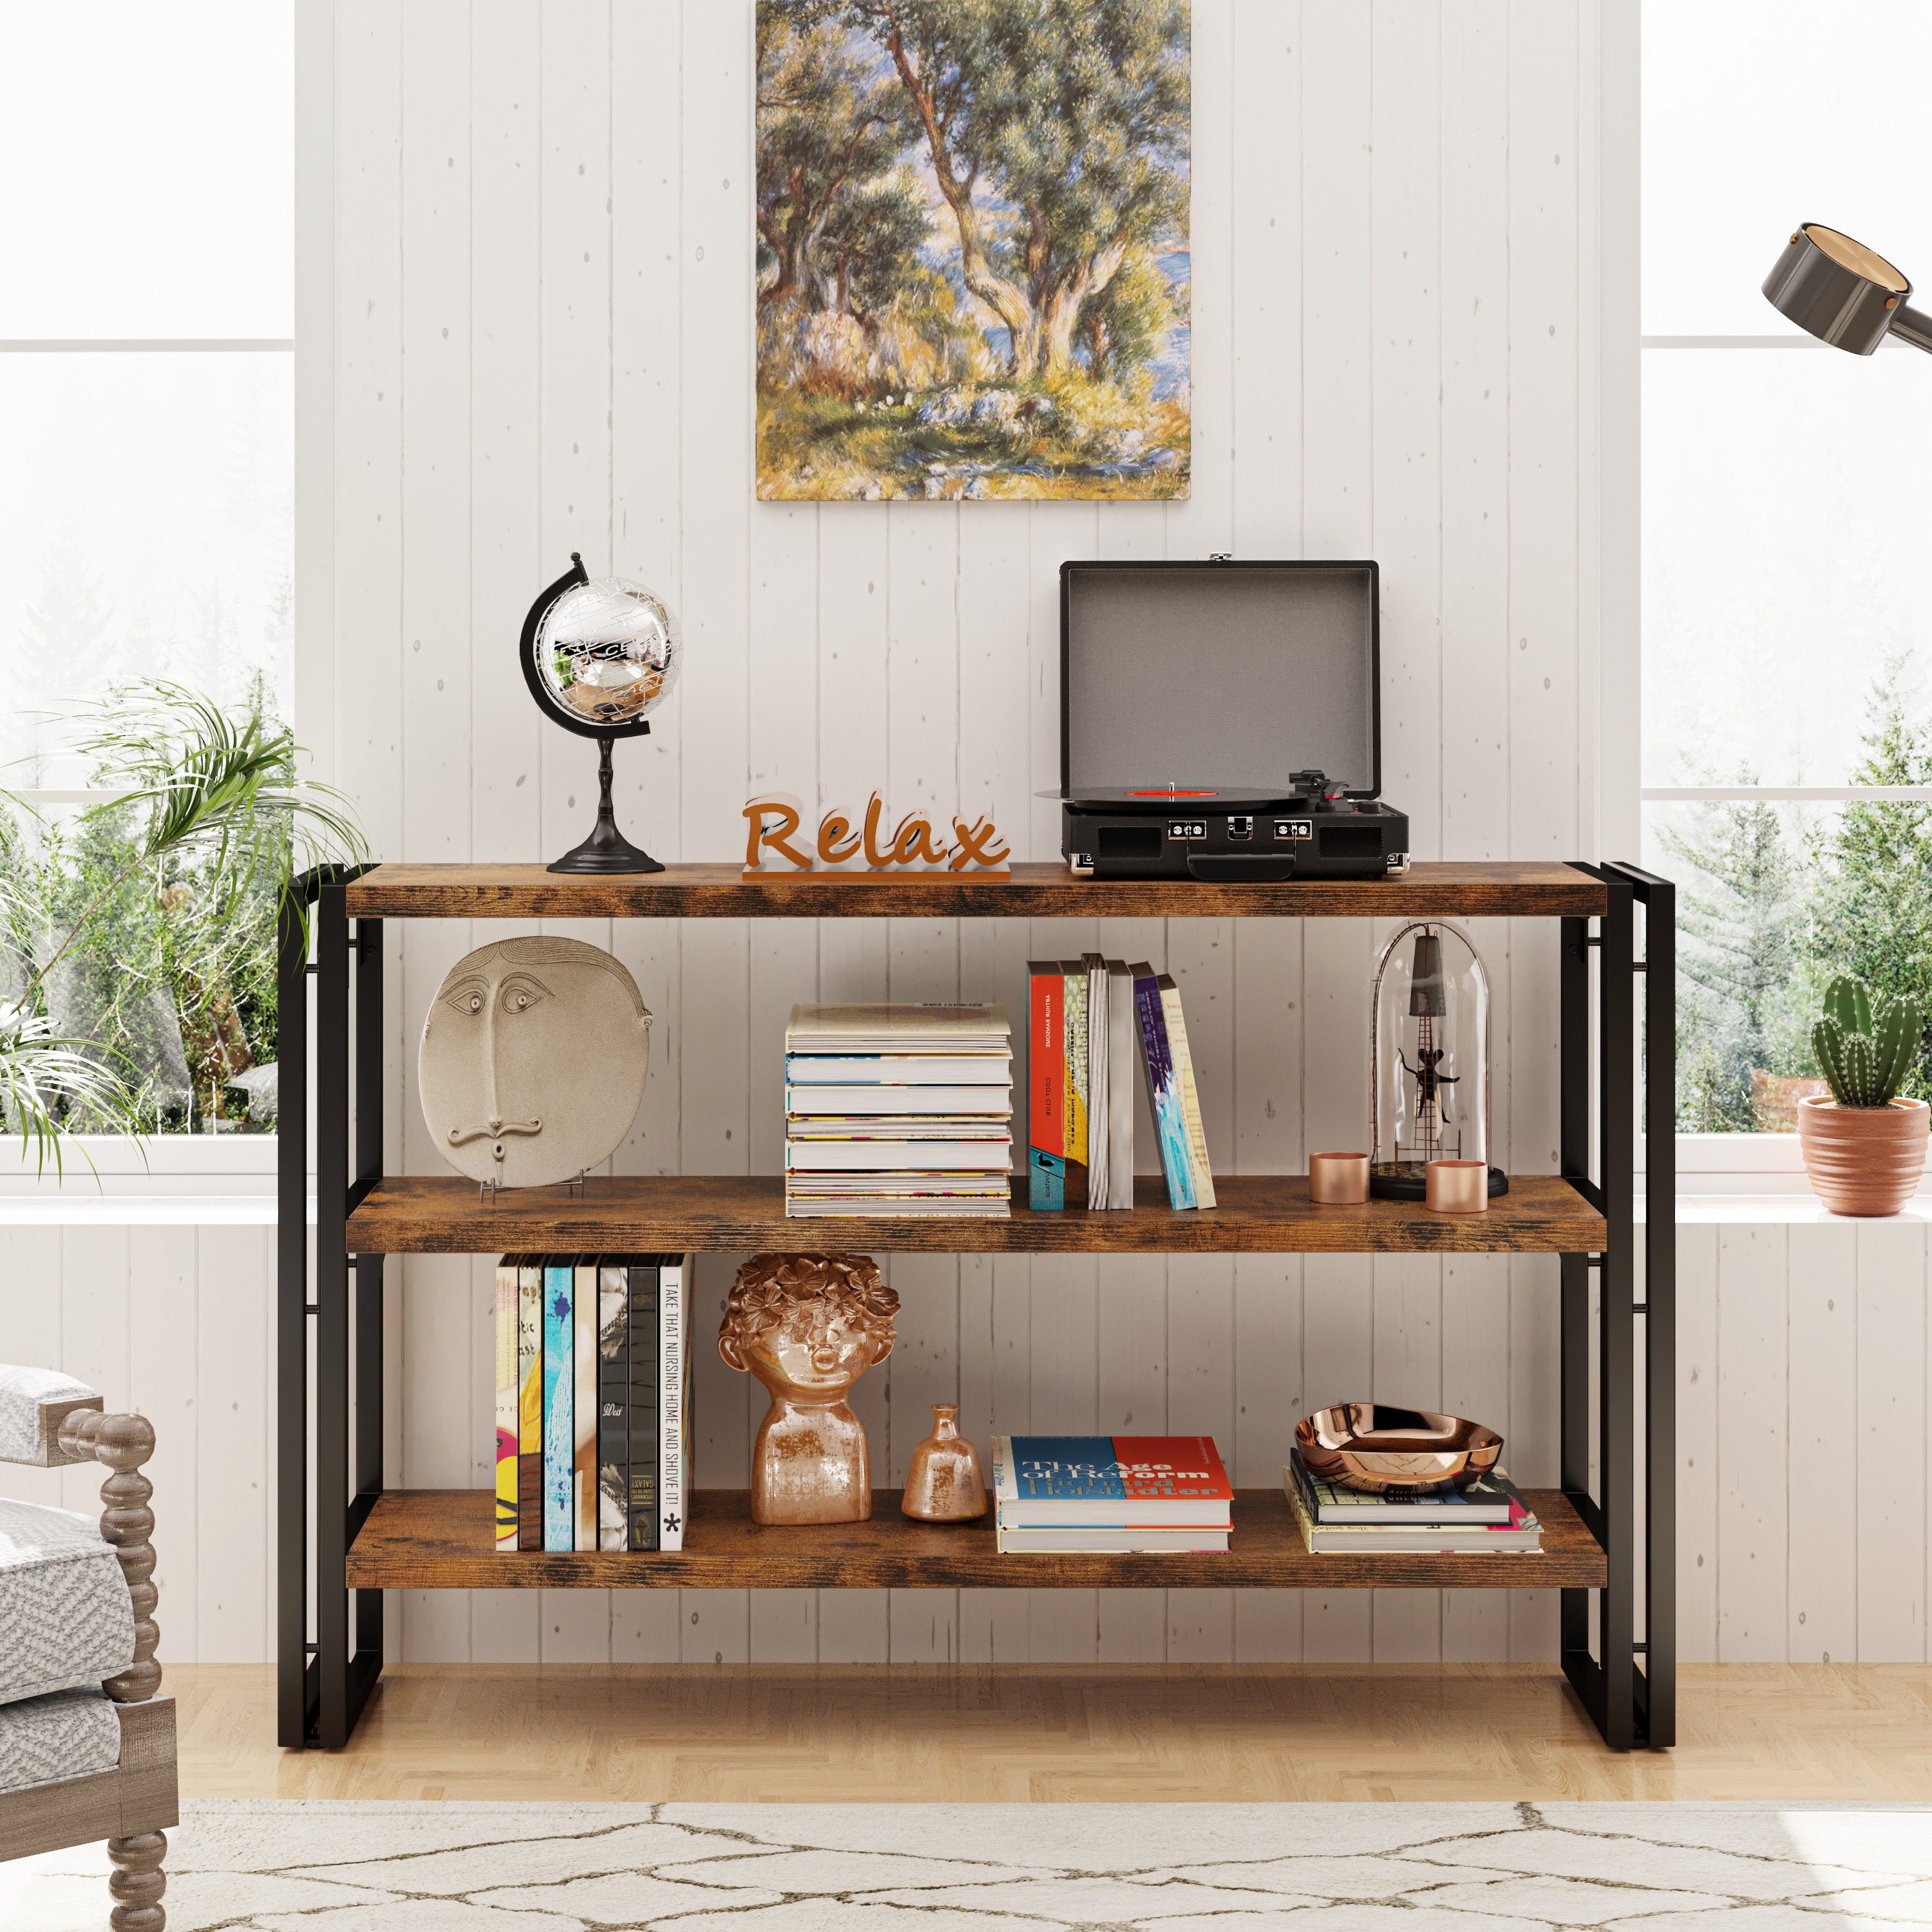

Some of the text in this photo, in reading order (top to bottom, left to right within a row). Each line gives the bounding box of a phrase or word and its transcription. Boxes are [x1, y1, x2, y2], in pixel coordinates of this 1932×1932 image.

[742, 791, 1011, 870] Relax
[665, 1283, 678, 1504] TAKE THAT NURSING HOME AND SHOVE IT!
[1022, 1461, 1172, 1472] The Age
[1022, 1470, 1209, 1479] of Reform
[631, 1479, 654, 1488] GALAXY
